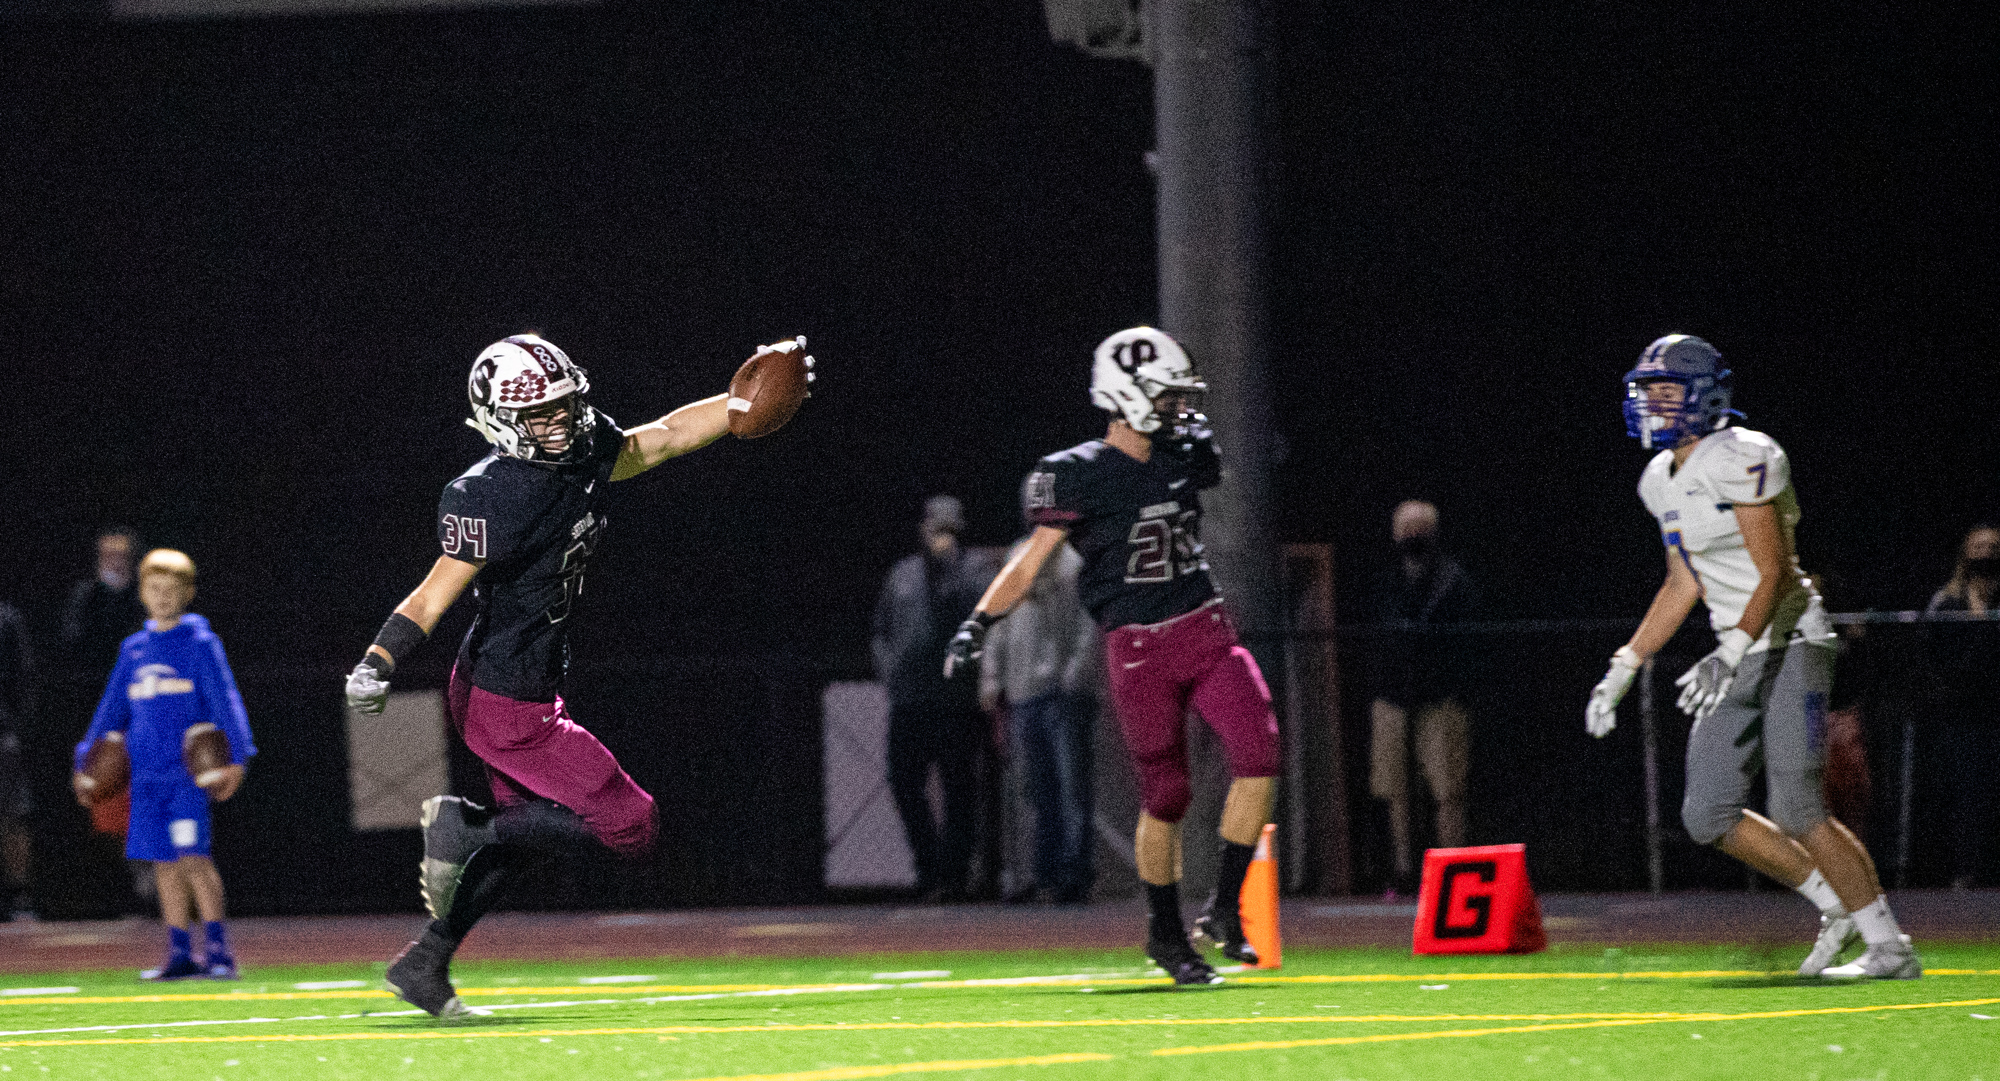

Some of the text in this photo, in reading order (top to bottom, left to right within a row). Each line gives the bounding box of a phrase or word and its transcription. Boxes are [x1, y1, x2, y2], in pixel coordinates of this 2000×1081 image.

[1747, 463, 1767, 498] 7
[442, 513, 487, 558] 34
[1434, 862, 1496, 939] G
